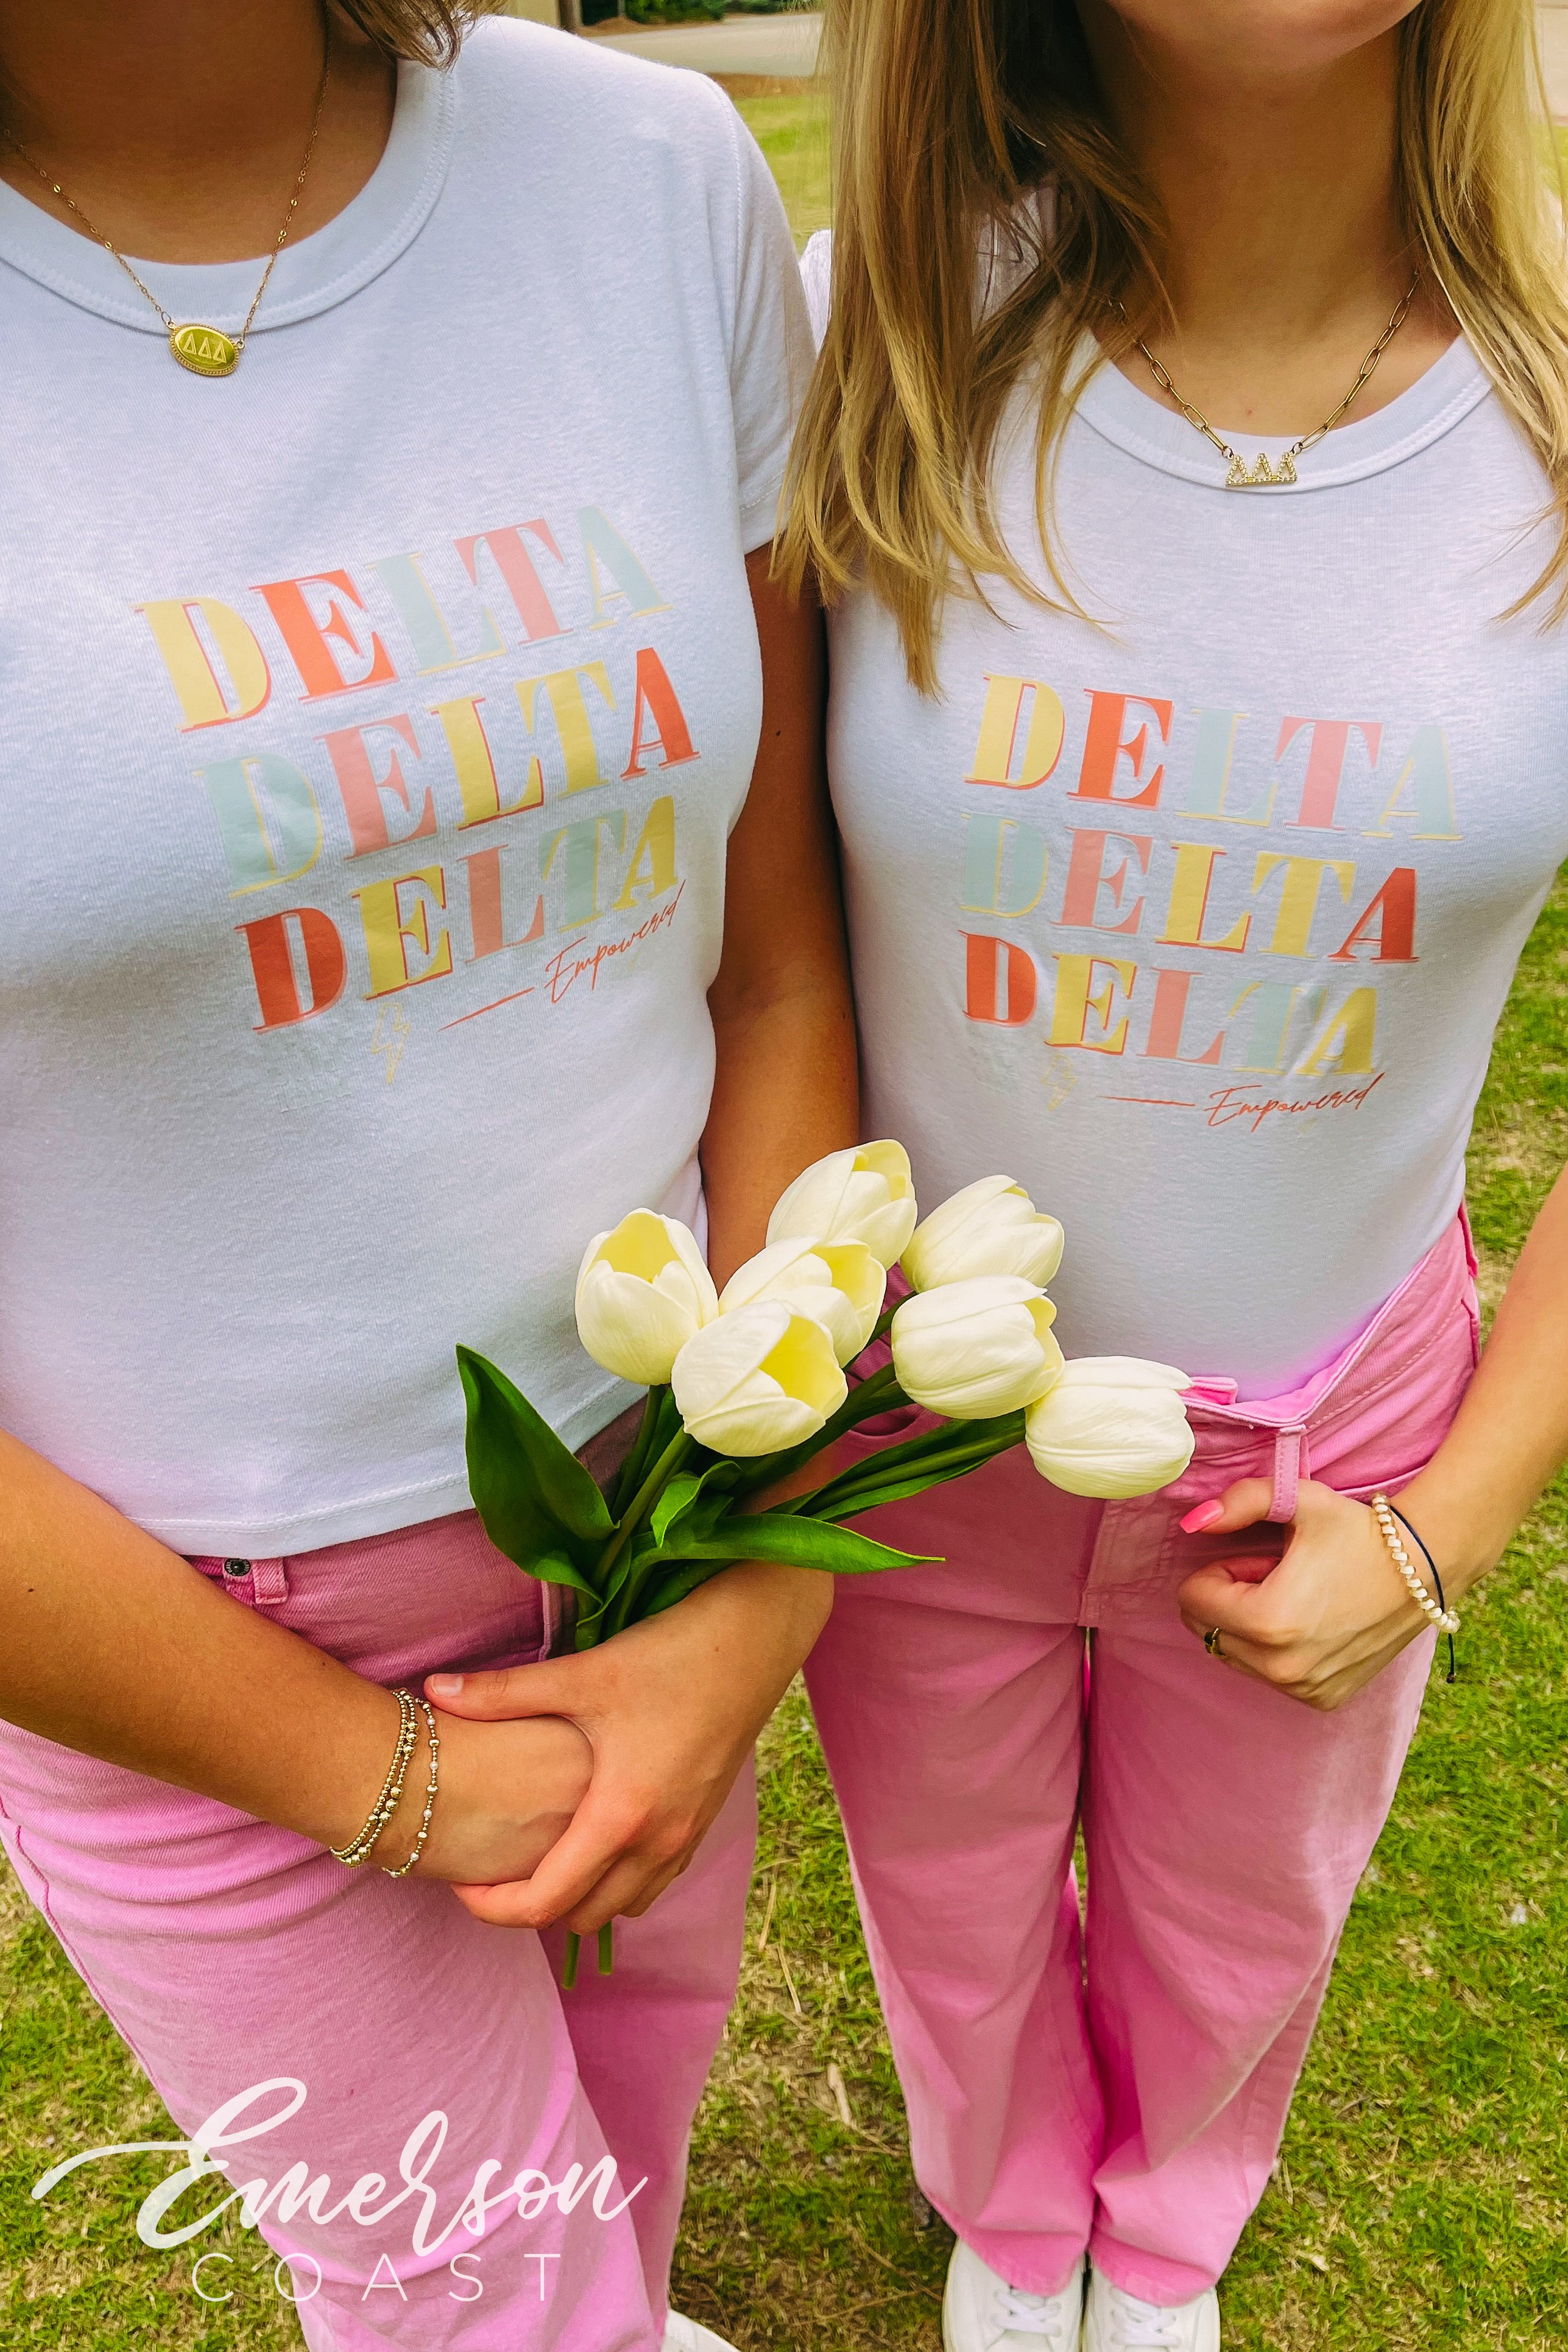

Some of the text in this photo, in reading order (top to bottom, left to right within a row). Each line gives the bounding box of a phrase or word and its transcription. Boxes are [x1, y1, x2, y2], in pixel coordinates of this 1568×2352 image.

[129, 507, 674, 733] DELTA
[192, 646, 702, 899] DELTA
[962, 670, 1464, 841] DELTA
[235, 794, 680, 1034] DELTA
[543, 880, 687, 1003] Empowered
[958, 811, 1419, 964] DELTA
[957, 930, 1379, 1076] DELTA
[1204, 1073, 1385, 1132] Empowered
